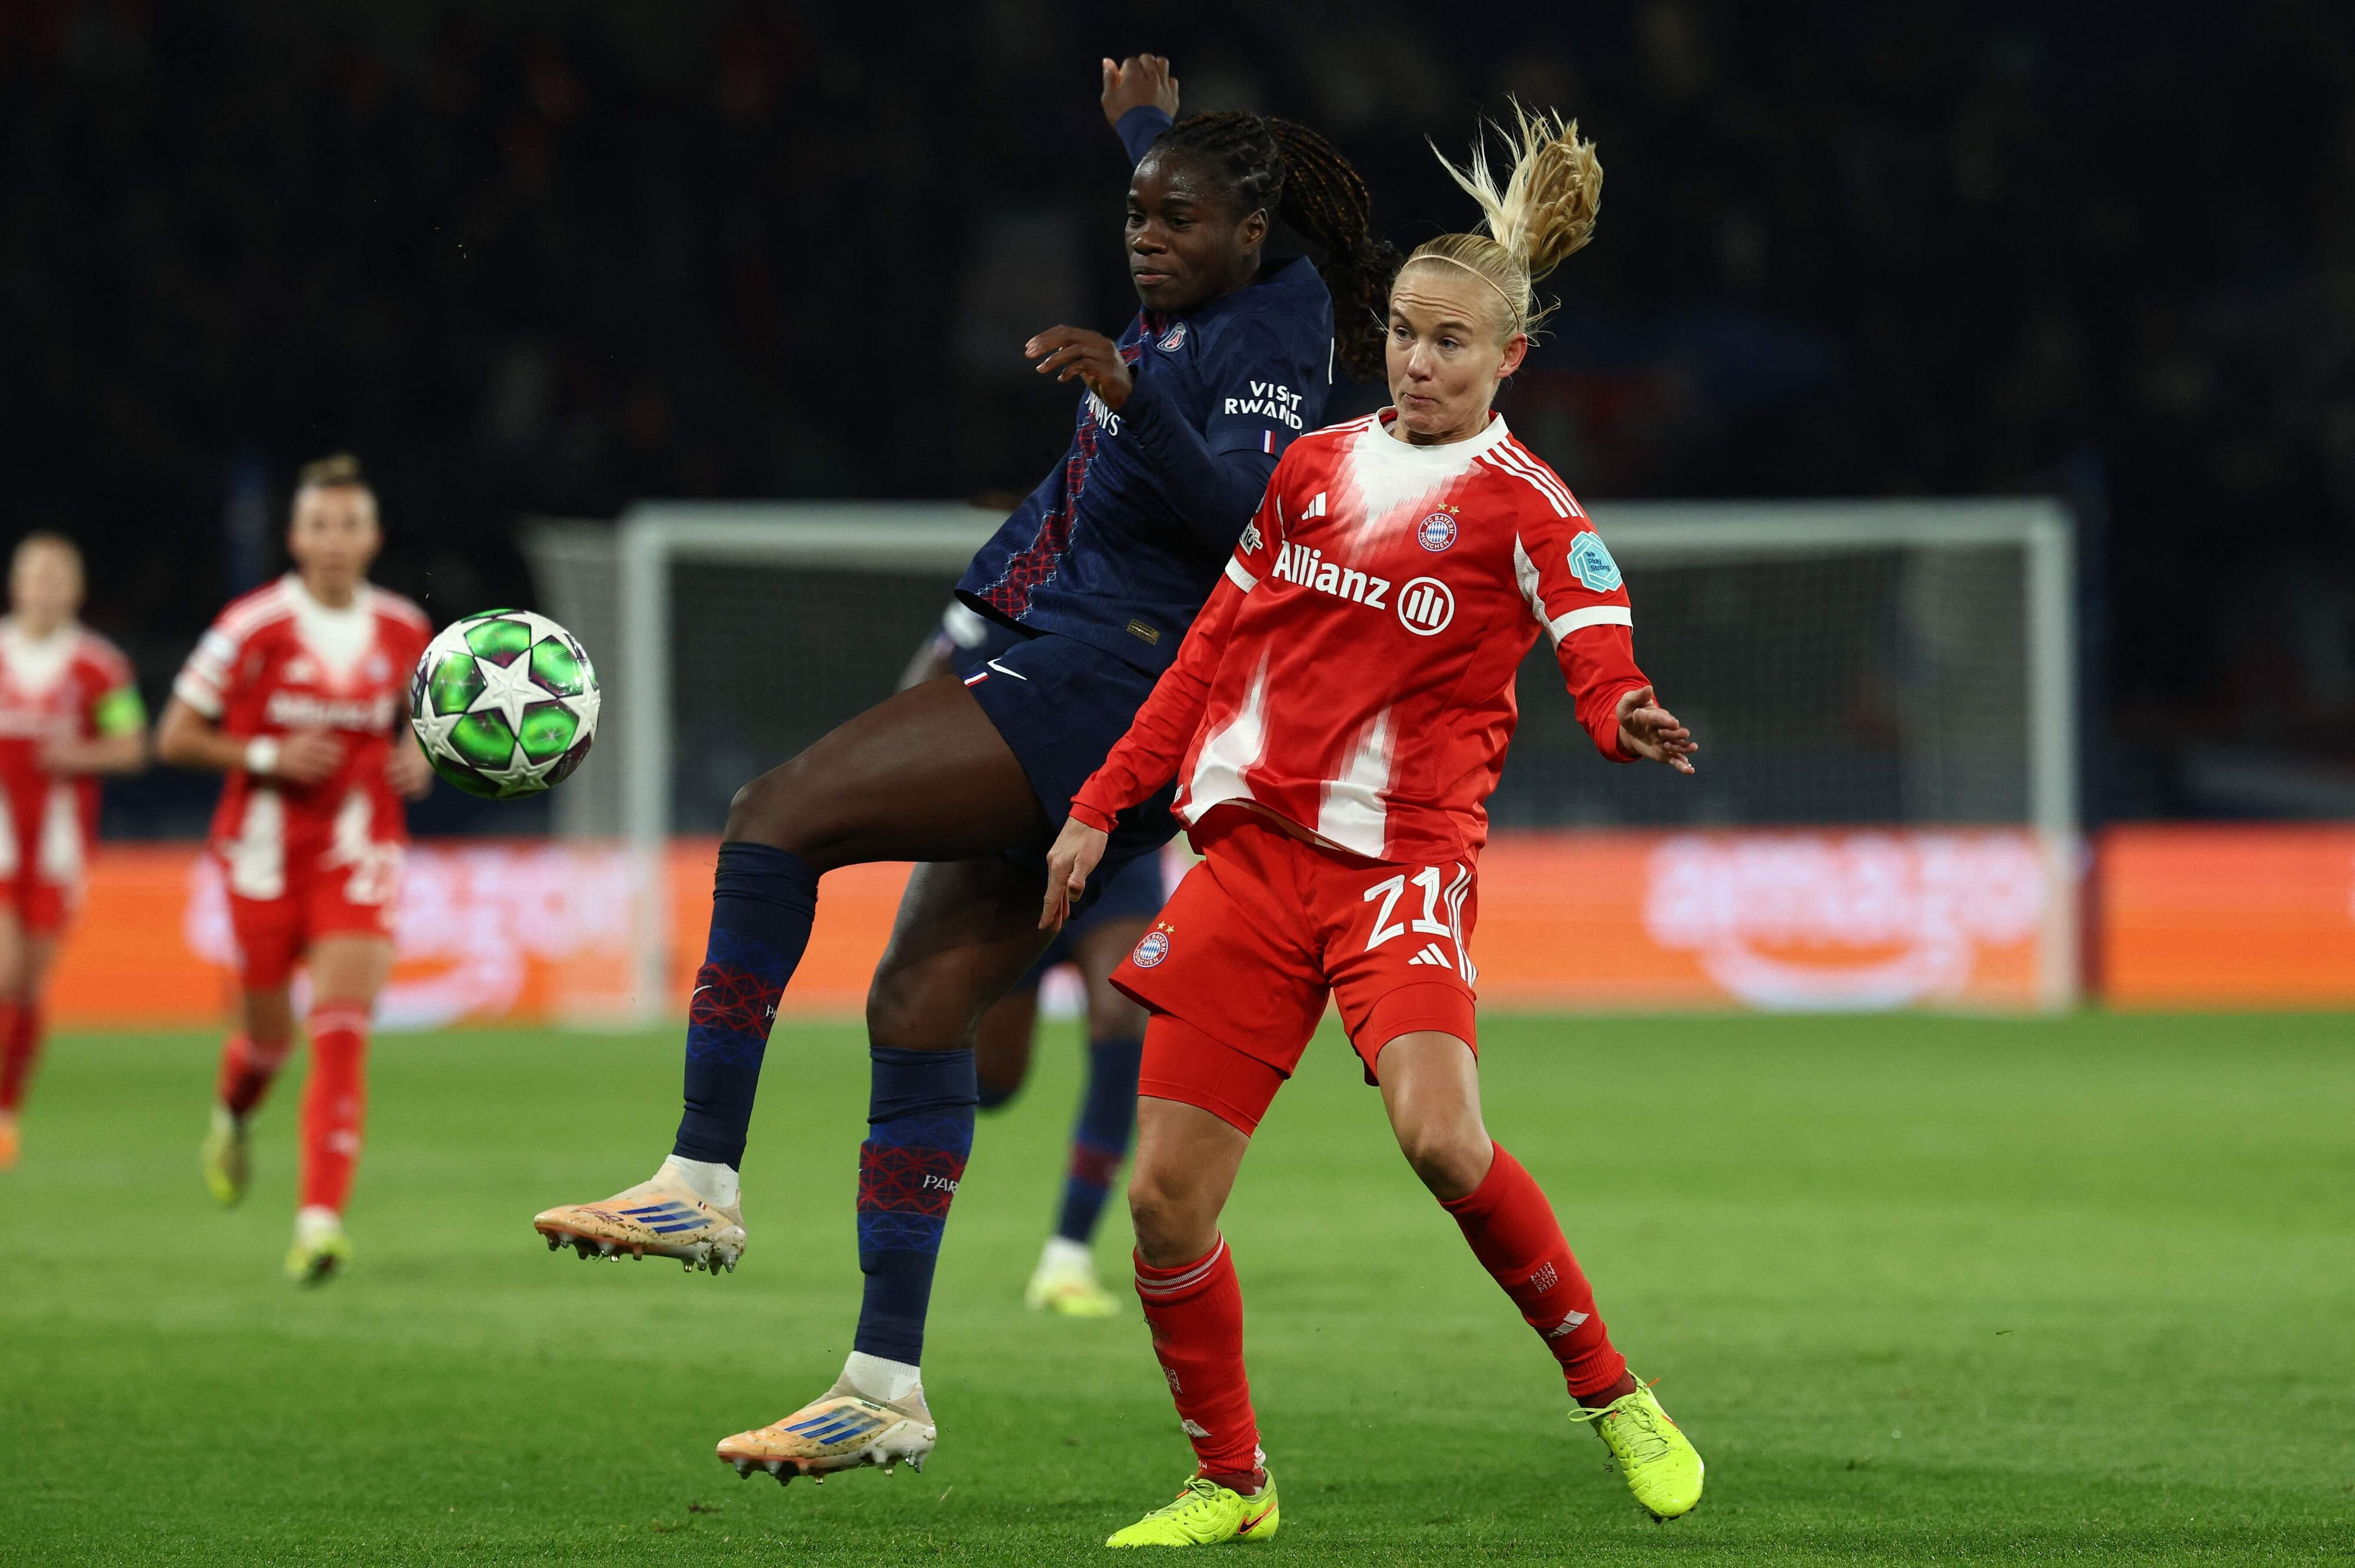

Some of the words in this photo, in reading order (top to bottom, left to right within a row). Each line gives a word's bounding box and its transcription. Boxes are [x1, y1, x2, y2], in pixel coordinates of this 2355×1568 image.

[1249, 380, 1303, 411] VISIT
[1225, 398, 1303, 431] RWAND
[1424, 517, 1433, 526] FC
[1435, 516, 1454, 534] BAYERN
[1272, 540, 1391, 610] Allianz
[1364, 866, 1452, 952] 21
[1152, 934, 1166, 953] BAYERN
